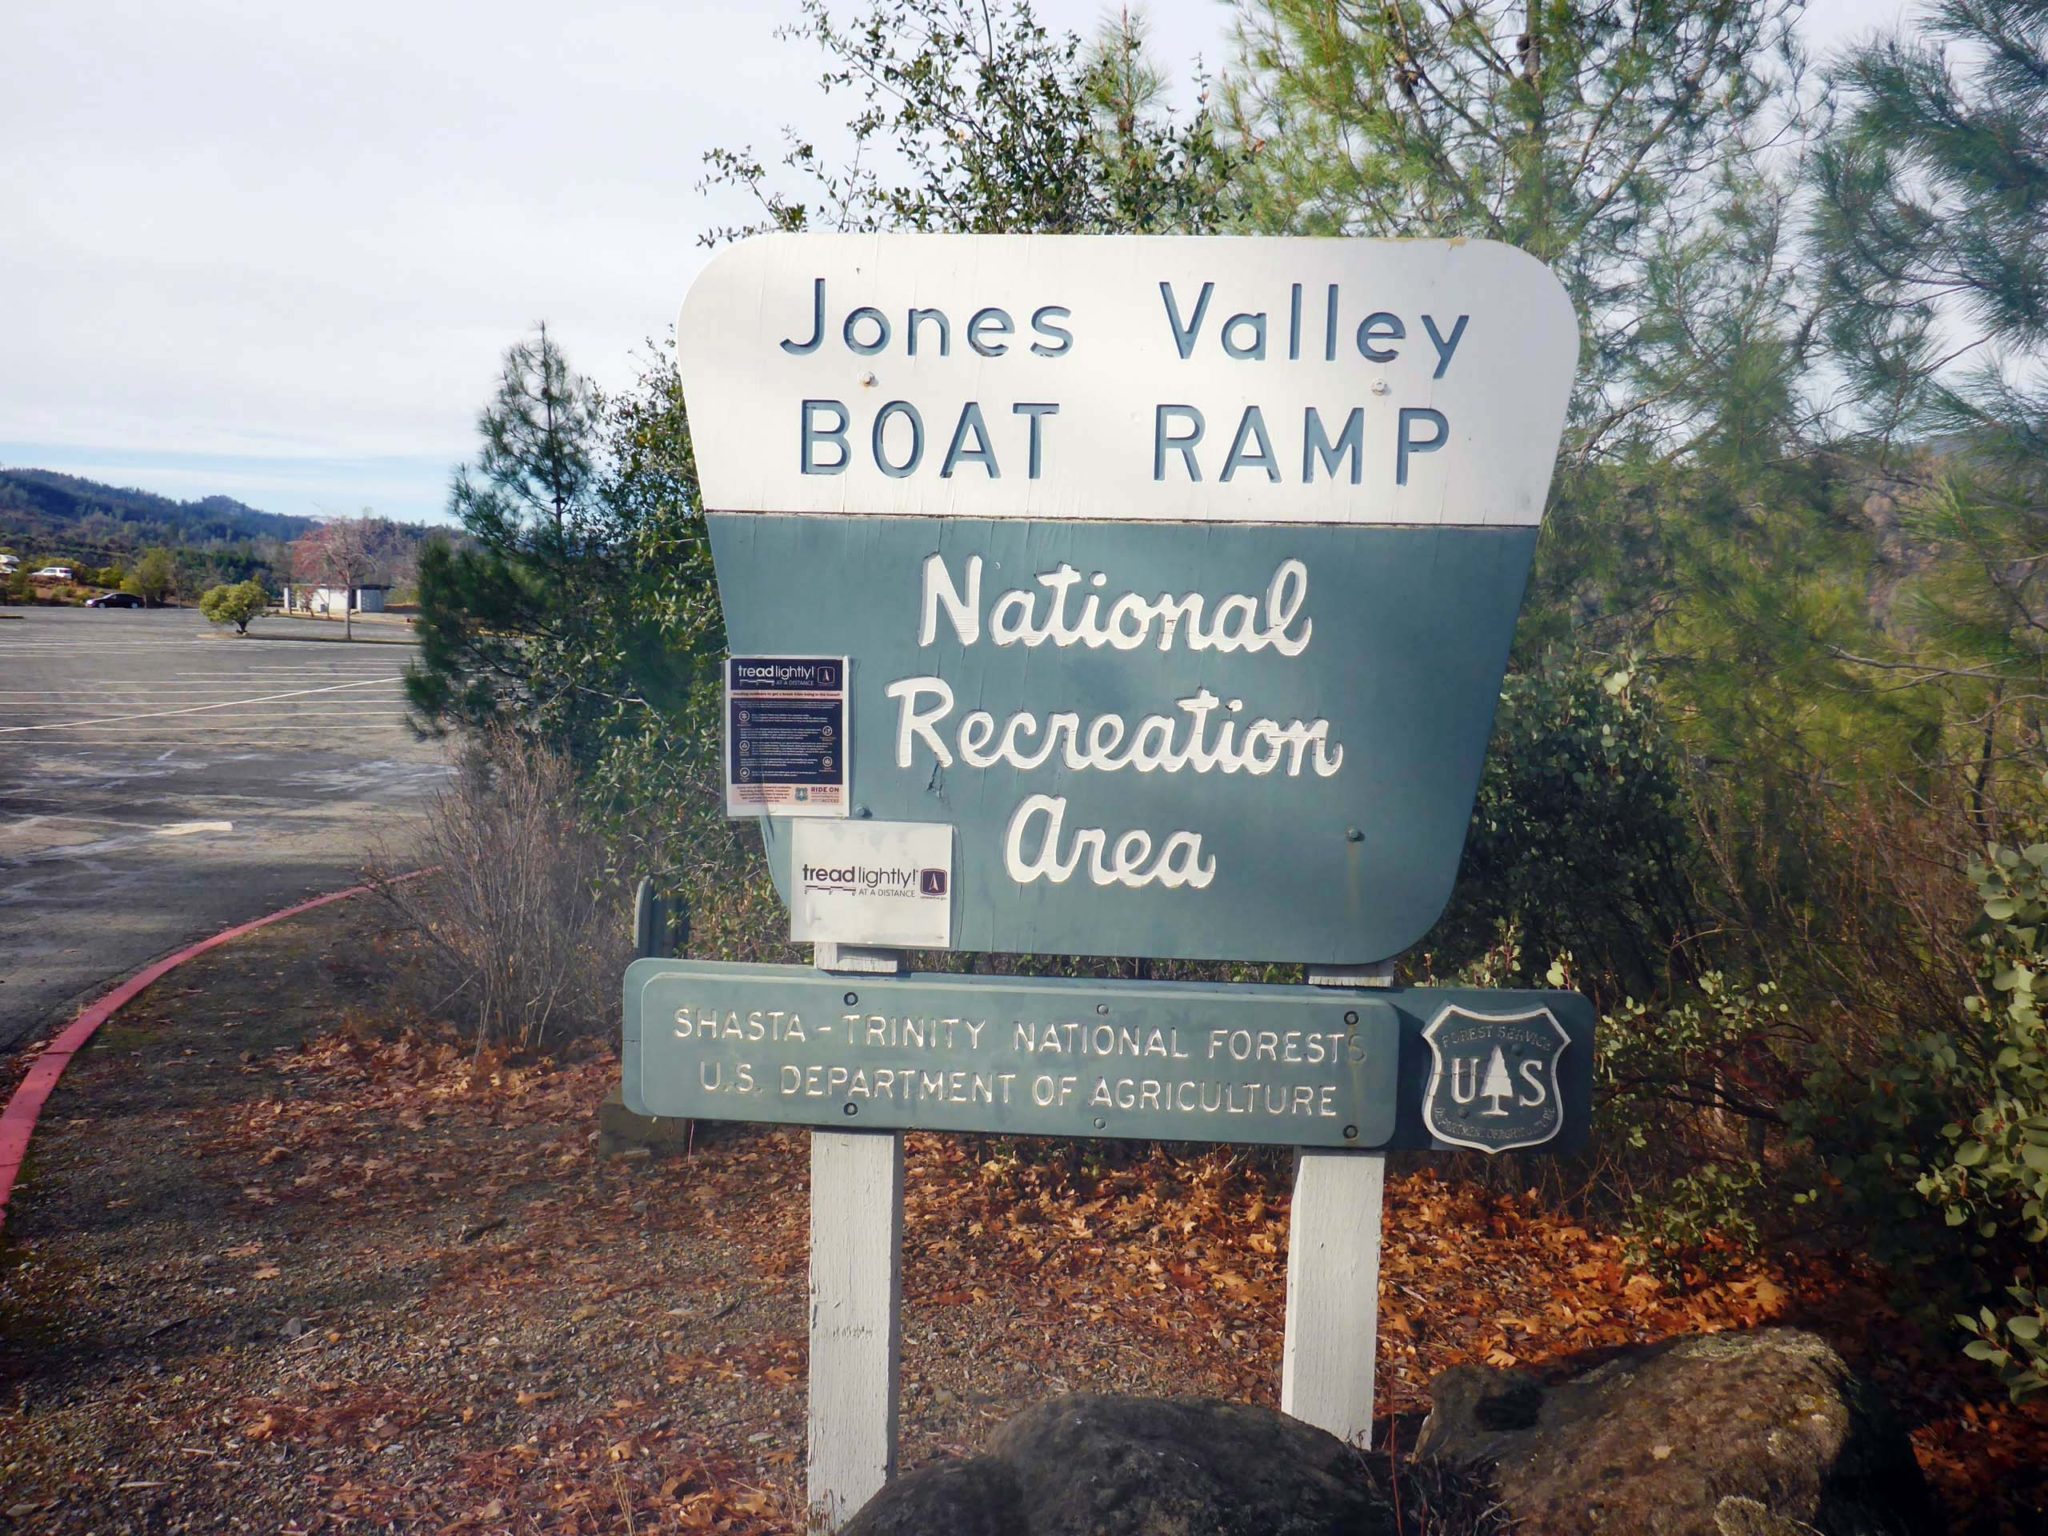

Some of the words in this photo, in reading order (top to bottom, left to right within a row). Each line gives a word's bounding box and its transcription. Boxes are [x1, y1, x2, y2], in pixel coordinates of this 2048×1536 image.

[780, 278, 1073, 357] Jones
[1159, 281, 1469, 379] Valley
[801, 399, 1059, 480] BOAT
[1153, 404, 1449, 486] RAMP
[917, 553, 1312, 656] National
[885, 676, 1343, 777] Recreation
[802, 864, 856, 882] tread
[1005, 794, 1216, 888] Area
[869, 889, 876, 897] A
[878, 889, 916, 898] DISTANCE
[1013, 1022, 1188, 1058] NATIONAL
[1208, 1029, 1366, 1064] FORESTS
[700, 1060, 763, 1097] U.S.
[780, 1065, 1016, 1103] DEPARTMENT
[1032, 1075, 1077, 1107] OF
[1089, 1077, 1337, 1117] AGRICULTURE
